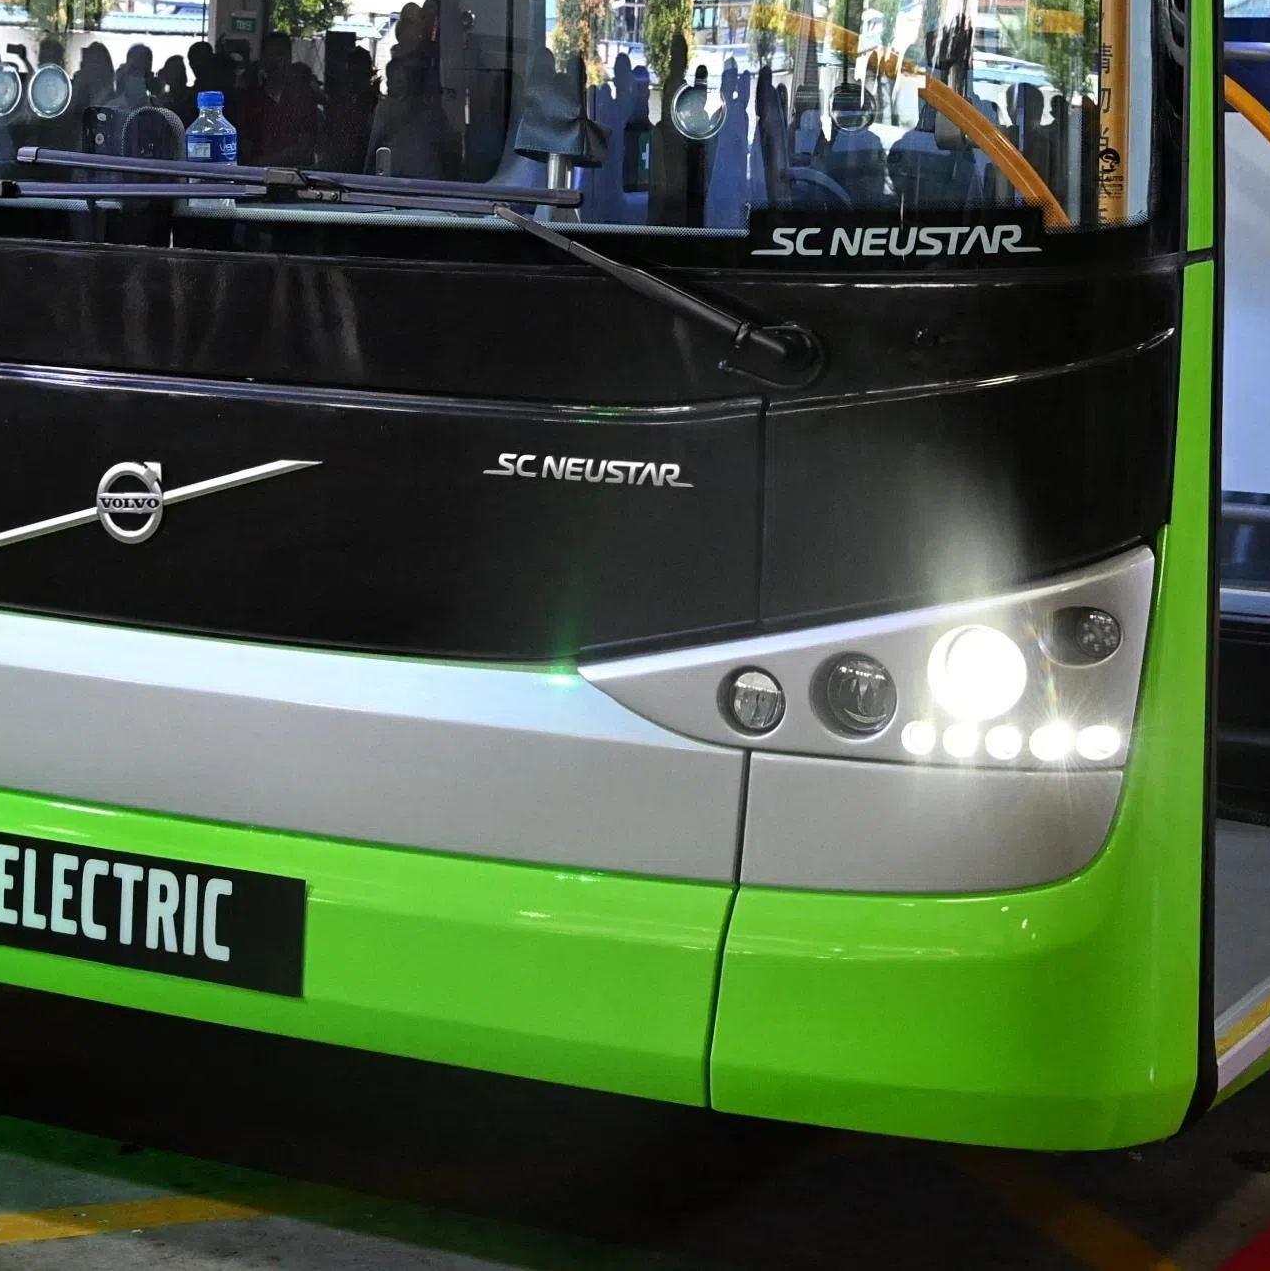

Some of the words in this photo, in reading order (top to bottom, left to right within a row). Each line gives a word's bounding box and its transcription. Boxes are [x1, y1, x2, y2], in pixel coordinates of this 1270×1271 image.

[750, 226, 824, 256] SC
[828, 223, 1044, 257] NEUSTAR
[482, 452, 538, 479] SC
[541, 455, 695, 488] NEUSTAR
[99, 497, 160, 509] VOLVO
